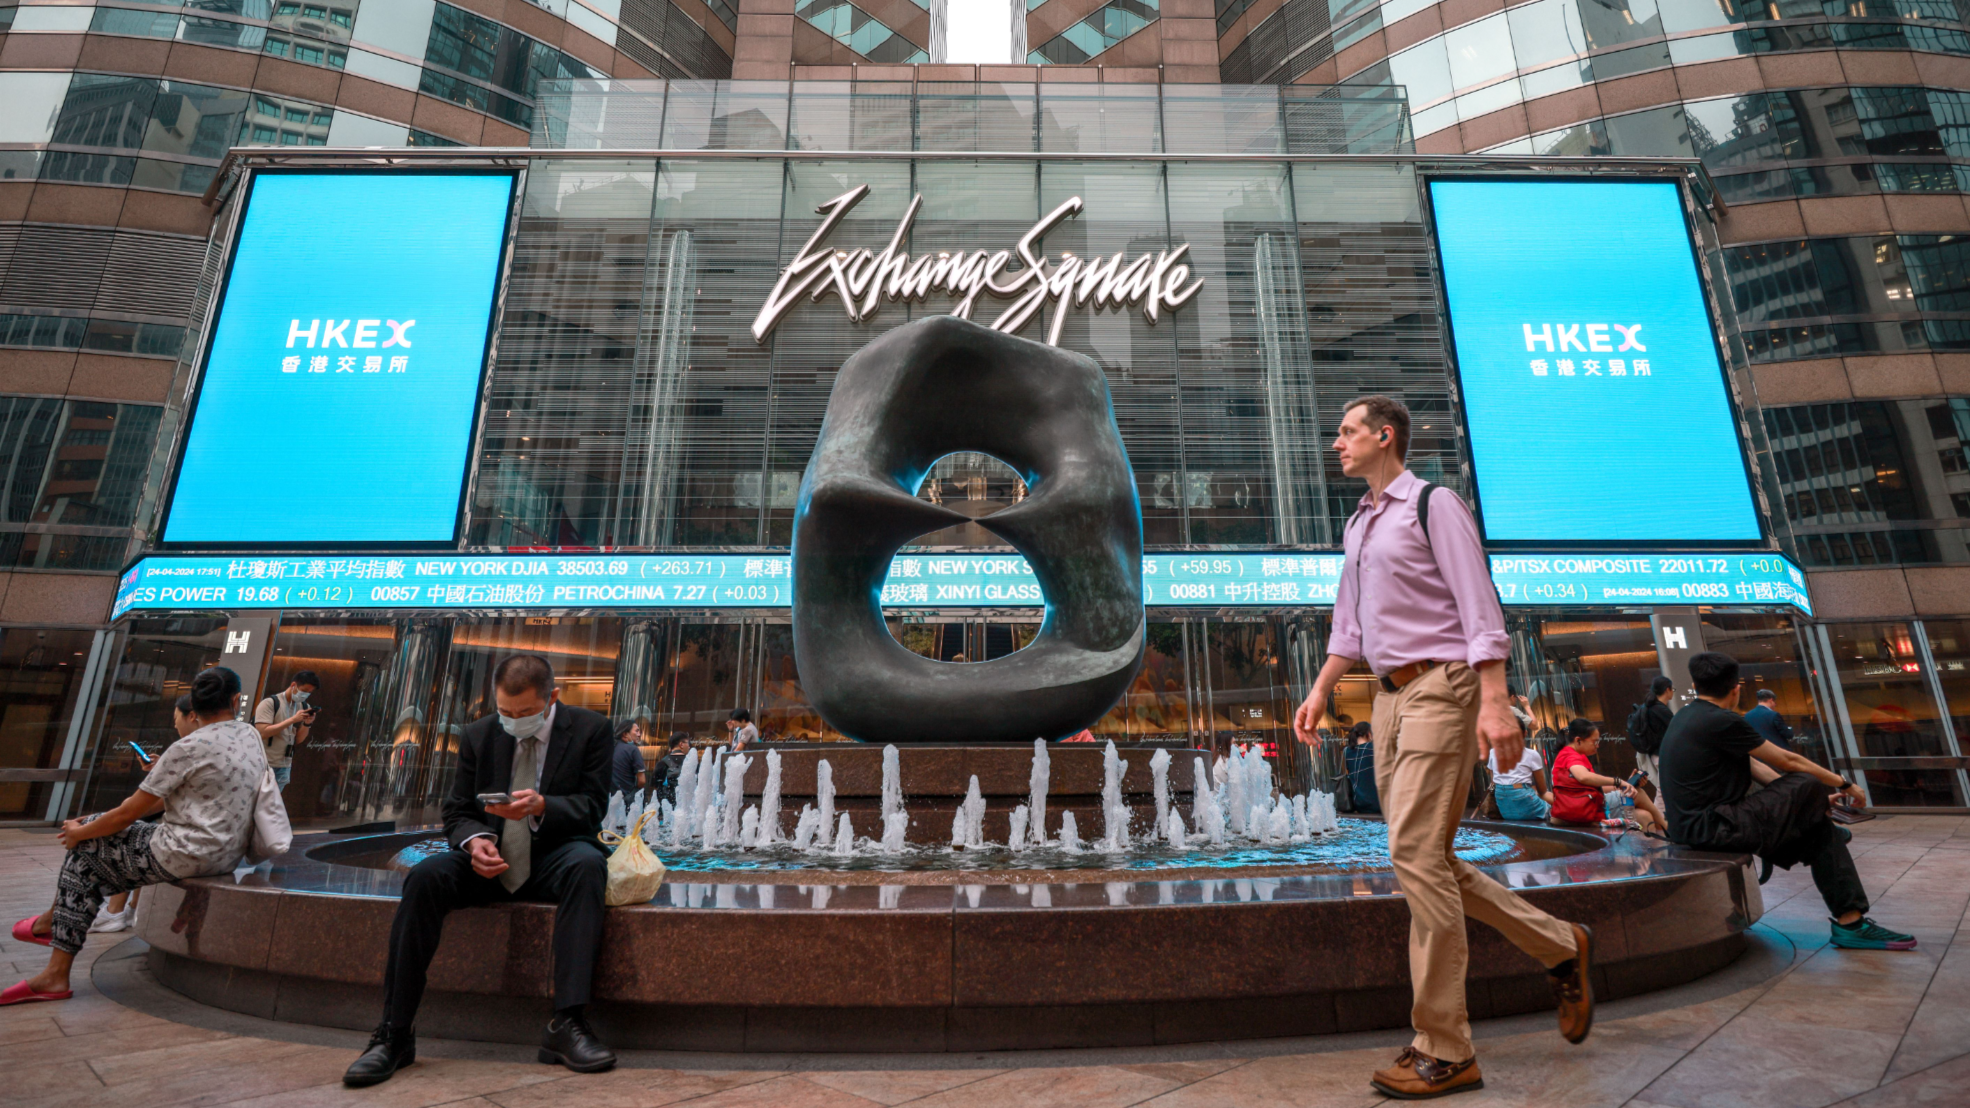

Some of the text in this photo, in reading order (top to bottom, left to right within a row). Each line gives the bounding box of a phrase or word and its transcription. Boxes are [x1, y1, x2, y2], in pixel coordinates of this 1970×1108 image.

[752, 184, 1205, 347] Exchange Square
[285, 318, 416, 349] HKEX
[1522, 323, 1647, 352] HKEX
[281, 355, 409, 373] 香港交易所
[1529, 358, 1652, 376] 香港交易所
[414, 561, 457, 576] NEW
[459, 561, 509, 576] YORK
[511, 560, 549, 576] DJIA
[556, 560, 629, 576] 38503.69
[928, 560, 969, 575] NEW
[971, 560, 1020, 575] YORK
[1261, 558, 1345, 577] 標準普爾
[1553, 559, 1651, 573] COMPOSITE
[1658, 559, 1729, 574] 22011.72
[159, 587, 227, 602] POWER
[237, 586, 280, 602] 19.68
[370, 586, 421, 601] 00857
[426, 584, 546, 604] 中國石油股份
[553, 585, 665, 600] PETROCHINA
[672, 585, 707, 600] 7.27
[935, 584, 981, 600] XINYI
[984, 584, 1041, 600] GLASS
[1169, 583, 1216, 599] 00881
[1224, 582, 1301, 602] 中升控股
[1682, 582, 1729, 598] 00883
